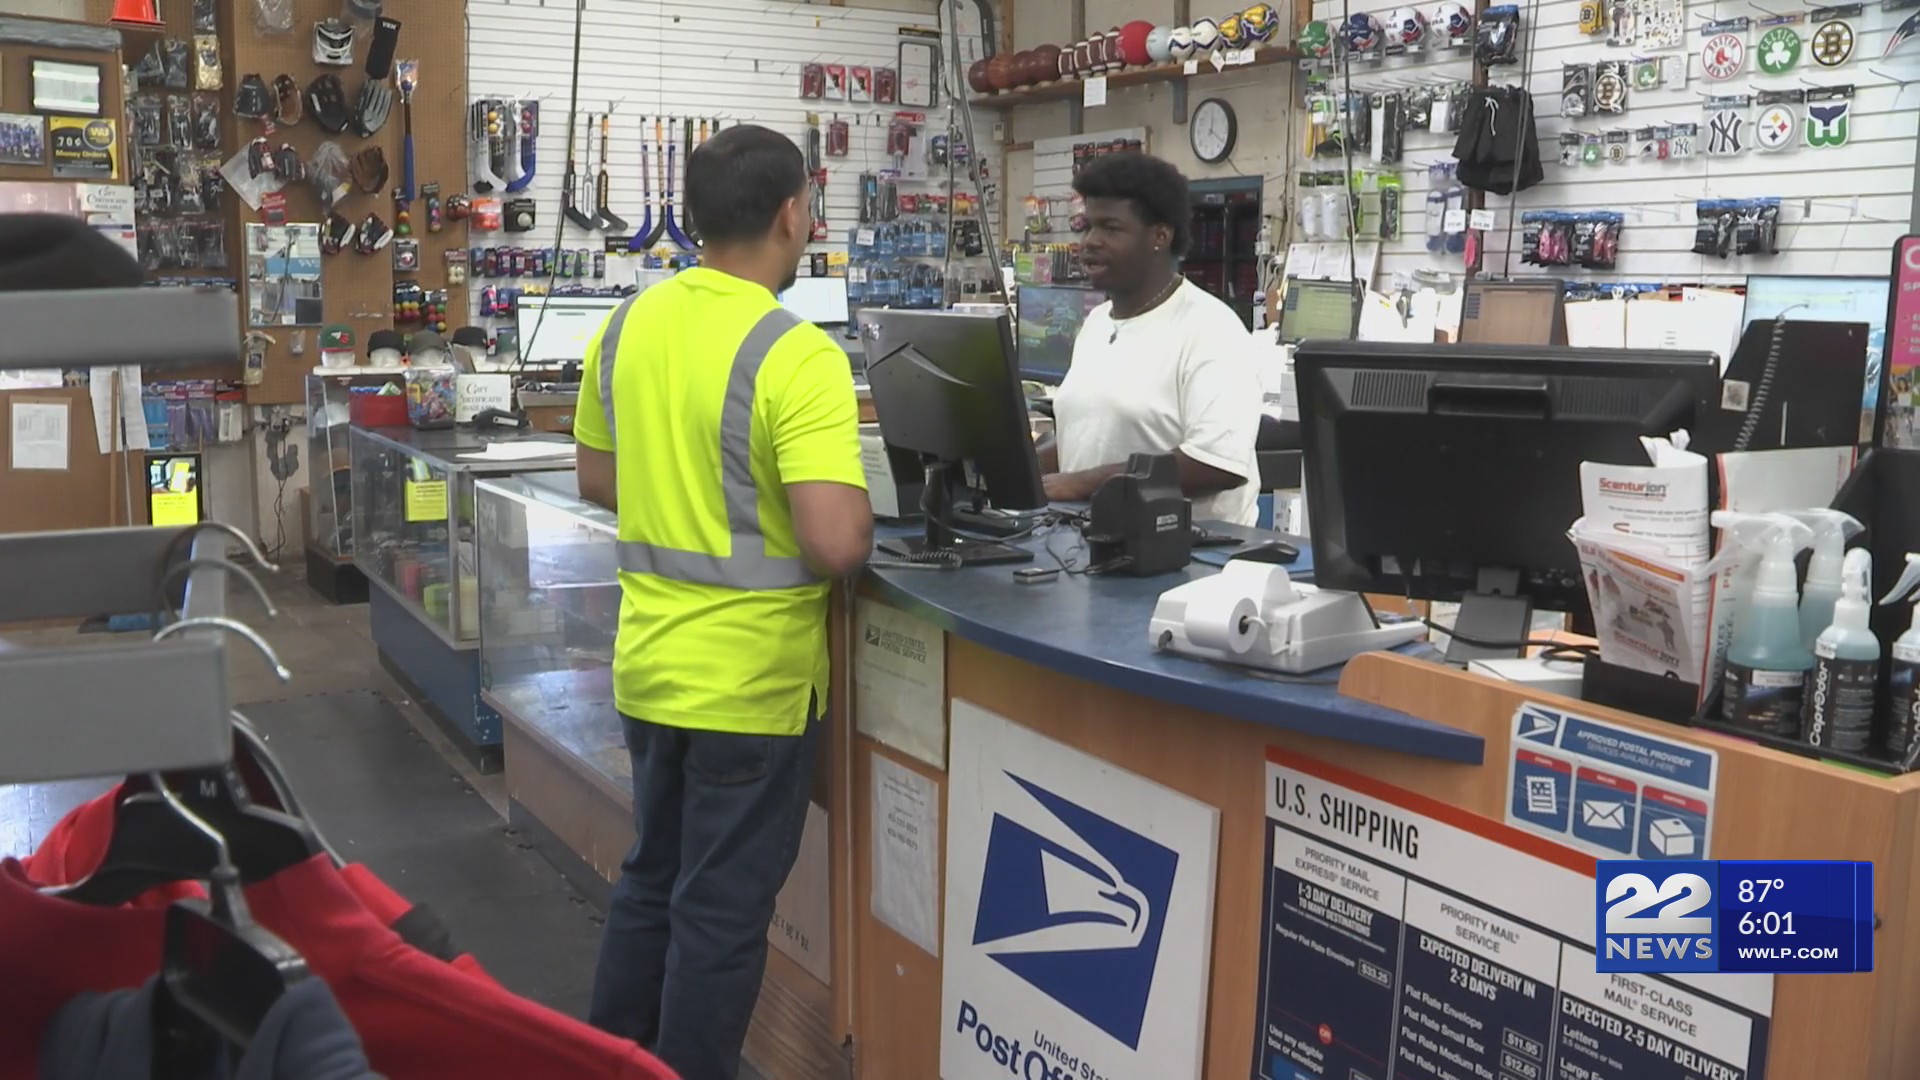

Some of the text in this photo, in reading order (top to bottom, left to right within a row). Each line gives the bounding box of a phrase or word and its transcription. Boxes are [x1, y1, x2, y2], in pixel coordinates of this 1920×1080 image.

[1760, 29, 1799, 52] CELTICS
[55, 150, 108, 161] Money Orders
[1576, 730, 1619, 750] APPROVED
[1618, 739, 1650, 758] POSTAL
[1275, 776, 1419, 861] U.S. SHIPPING
[1304, 846, 1370, 882] PRIORITY MAIL
[1340, 876, 1380, 902] SERVICE
[1312, 887, 1330, 906] DAY
[1329, 893, 1374, 927] DELIVERY
[1440, 902, 1488, 932] PRIORITY
[1455, 925, 1501, 954] SERVICE
[1419, 934, 1537, 1000] EXPECTED DELIVERY IN
[1449, 968, 1498, 1002] 2-3 DAYS
[1610, 974, 1694, 1018] FIRST-CLASS
[1405, 983, 1484, 1032] Flat Rate Envelope
[1640, 1003, 1698, 1038] SERVICE
[956, 999, 1022, 1076] Post
[1268, 1023, 1284, 1041] Use
[1403, 1004, 1485, 1055] Flat Rate Small Box
[1507, 1032, 1539, 1056] $11.95
[1561, 996, 1623, 1037] EXPECTED
[1622, 1023, 1646, 1048] 2-5
[1646, 1035, 1673, 1060] DAY
[1562, 1023, 1600, 1050] Letters
[1033, 1029, 1079, 1071] United
[1399, 1046, 1417, 1063] Flat
[1416, 1053, 1438, 1075] Rate
[1401, 1025, 1494, 1080] Flat Rate Medium Box
[1504, 1053, 1537, 1079] $12.65
